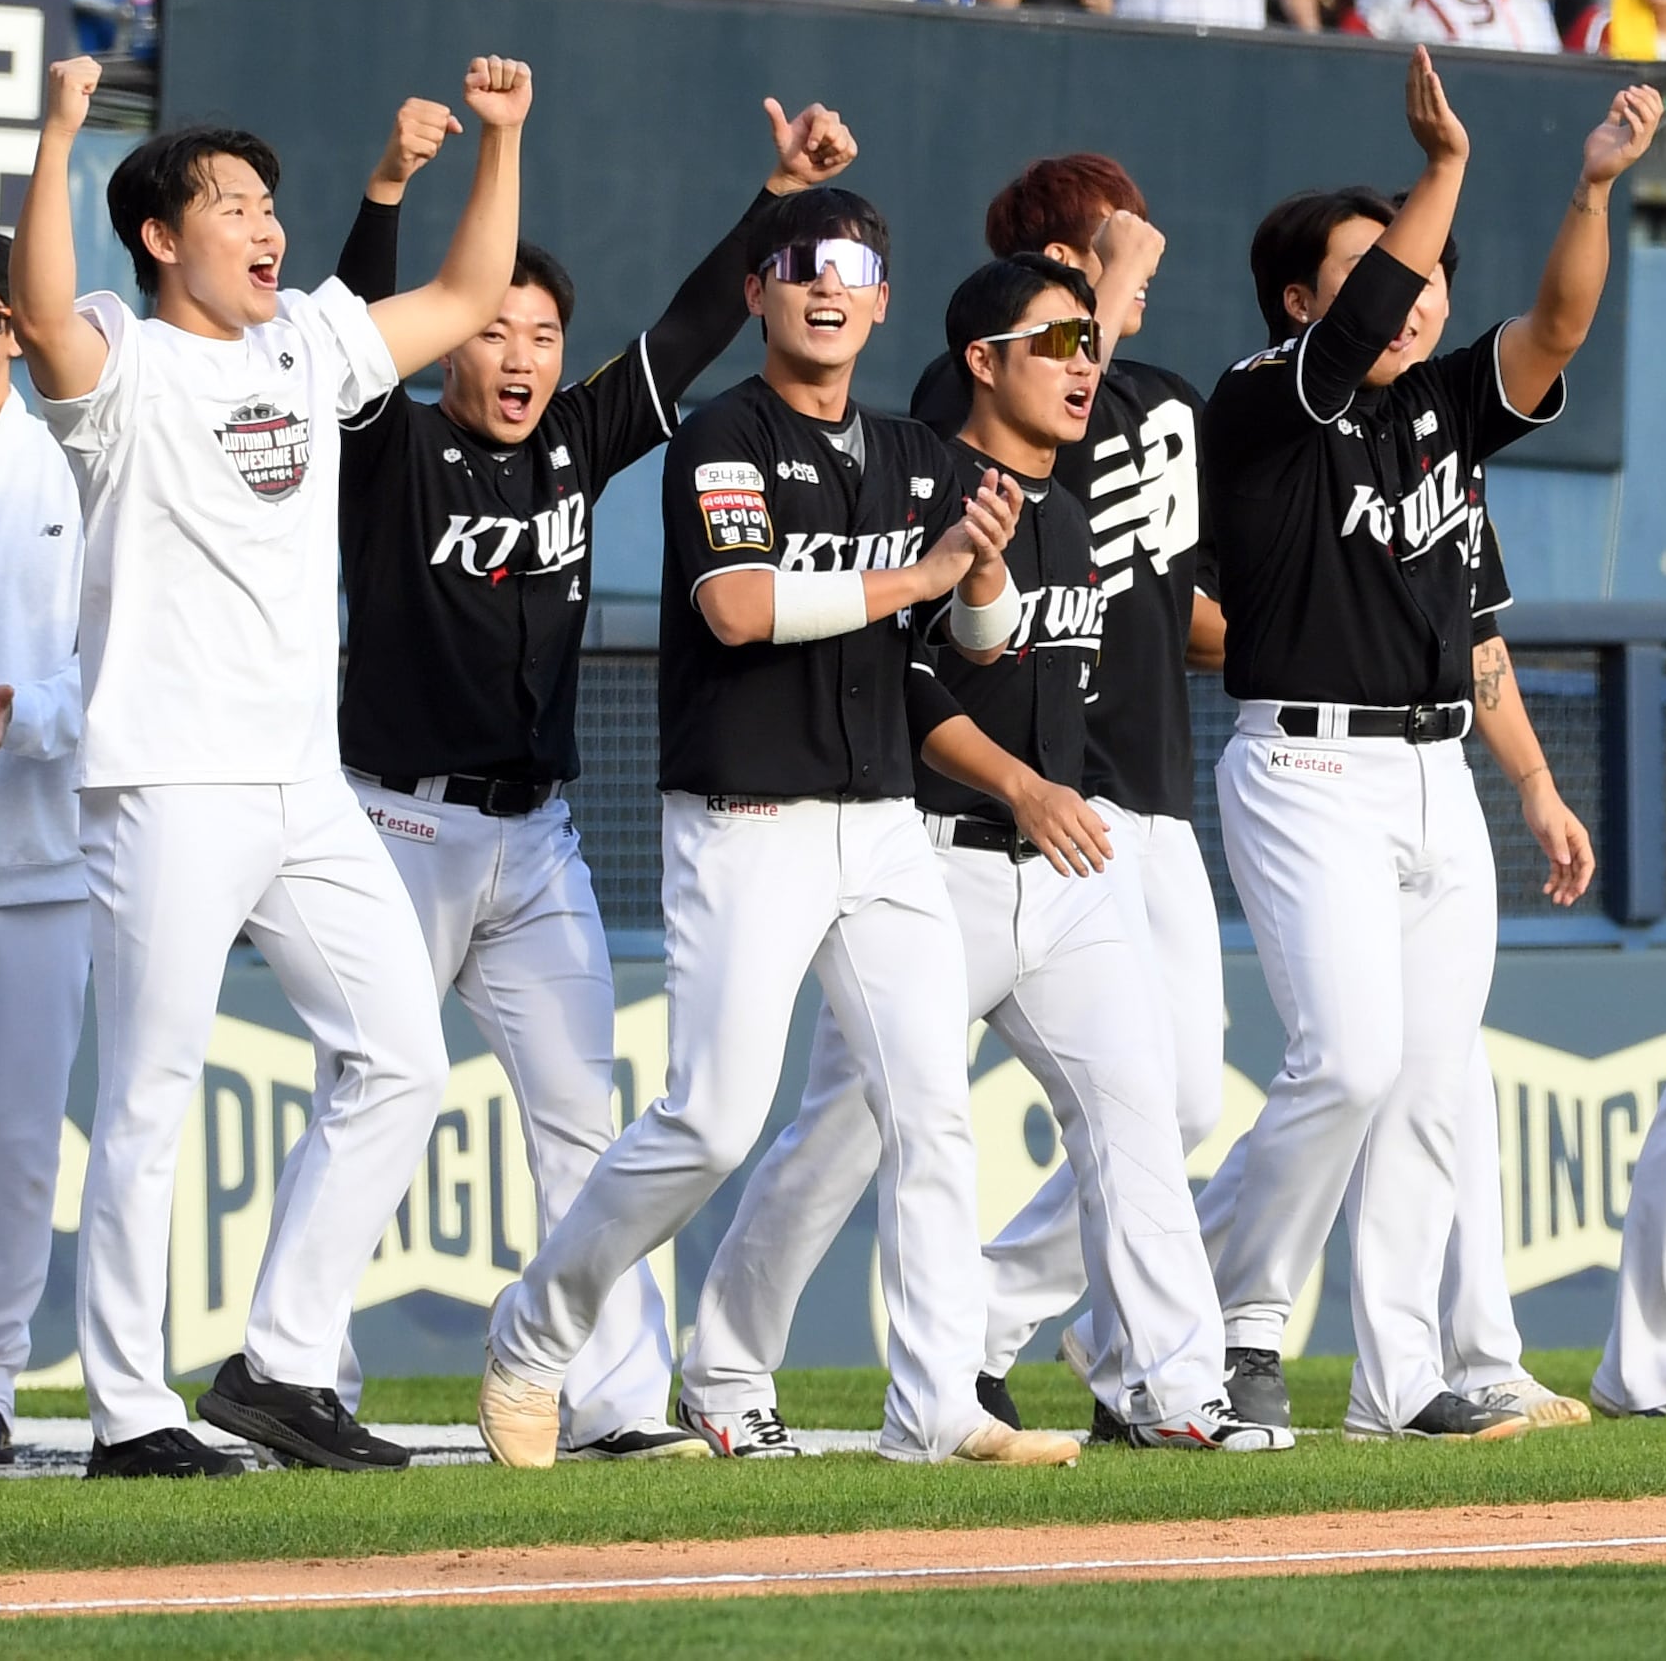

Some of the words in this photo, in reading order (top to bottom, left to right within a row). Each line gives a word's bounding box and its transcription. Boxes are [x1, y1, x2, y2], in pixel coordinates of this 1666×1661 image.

[221, 431, 274, 452] AUTUMN
[272, 419, 310, 448] MAGIC
[229, 445, 293, 472] WESOME
[709, 509, 768, 529] 타이어
[1271, 751, 1292, 768] kt
[1294, 757, 1344, 775] estate
[706, 794, 728, 812] kt
[729, 800, 779, 818] estate
[387, 817, 436, 839] estate
